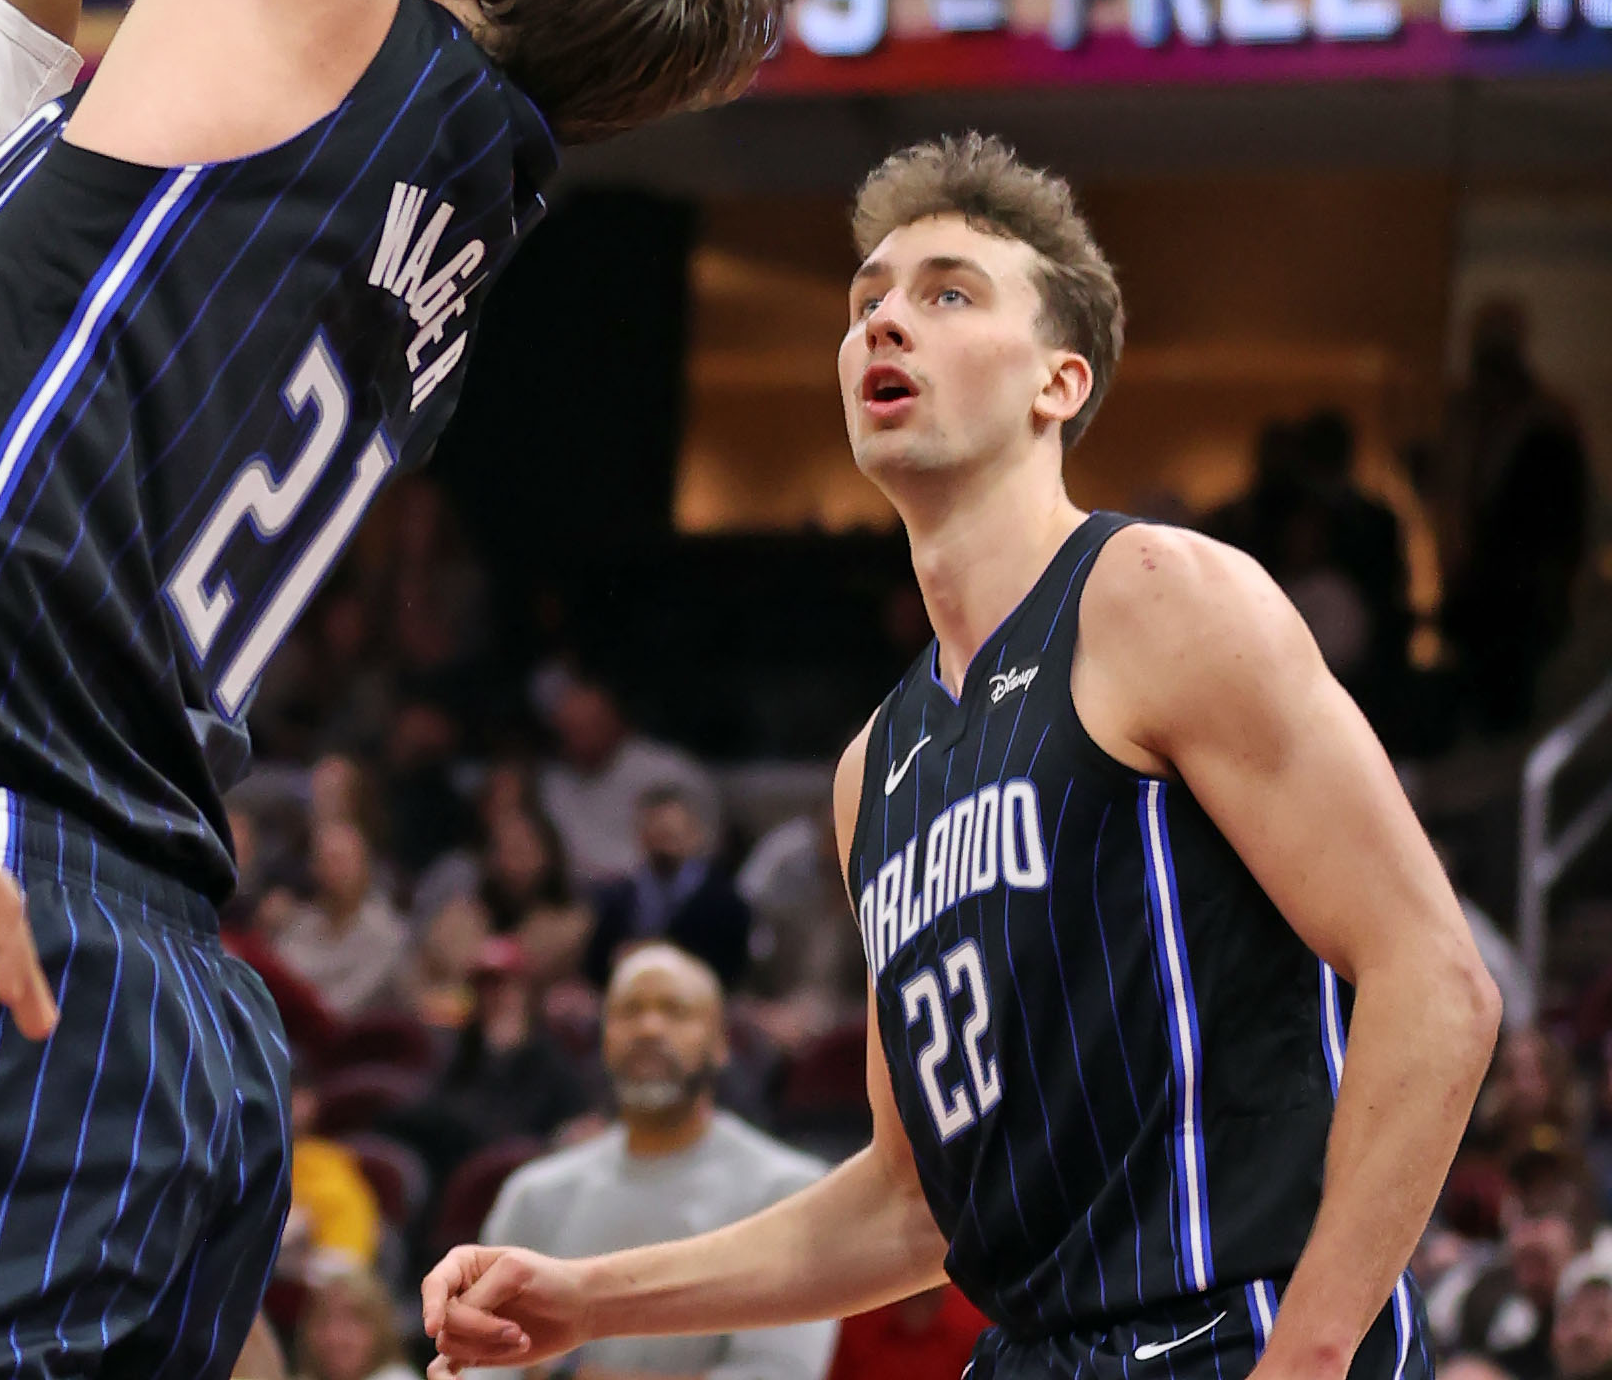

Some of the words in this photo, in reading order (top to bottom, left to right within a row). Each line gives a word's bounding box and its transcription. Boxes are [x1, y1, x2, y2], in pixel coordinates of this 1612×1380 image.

[367, 180, 489, 413] WAGER
[161, 324, 396, 721] 21
[859, 777, 1048, 991] ORLANDO
[899, 935, 1003, 1144] 22
